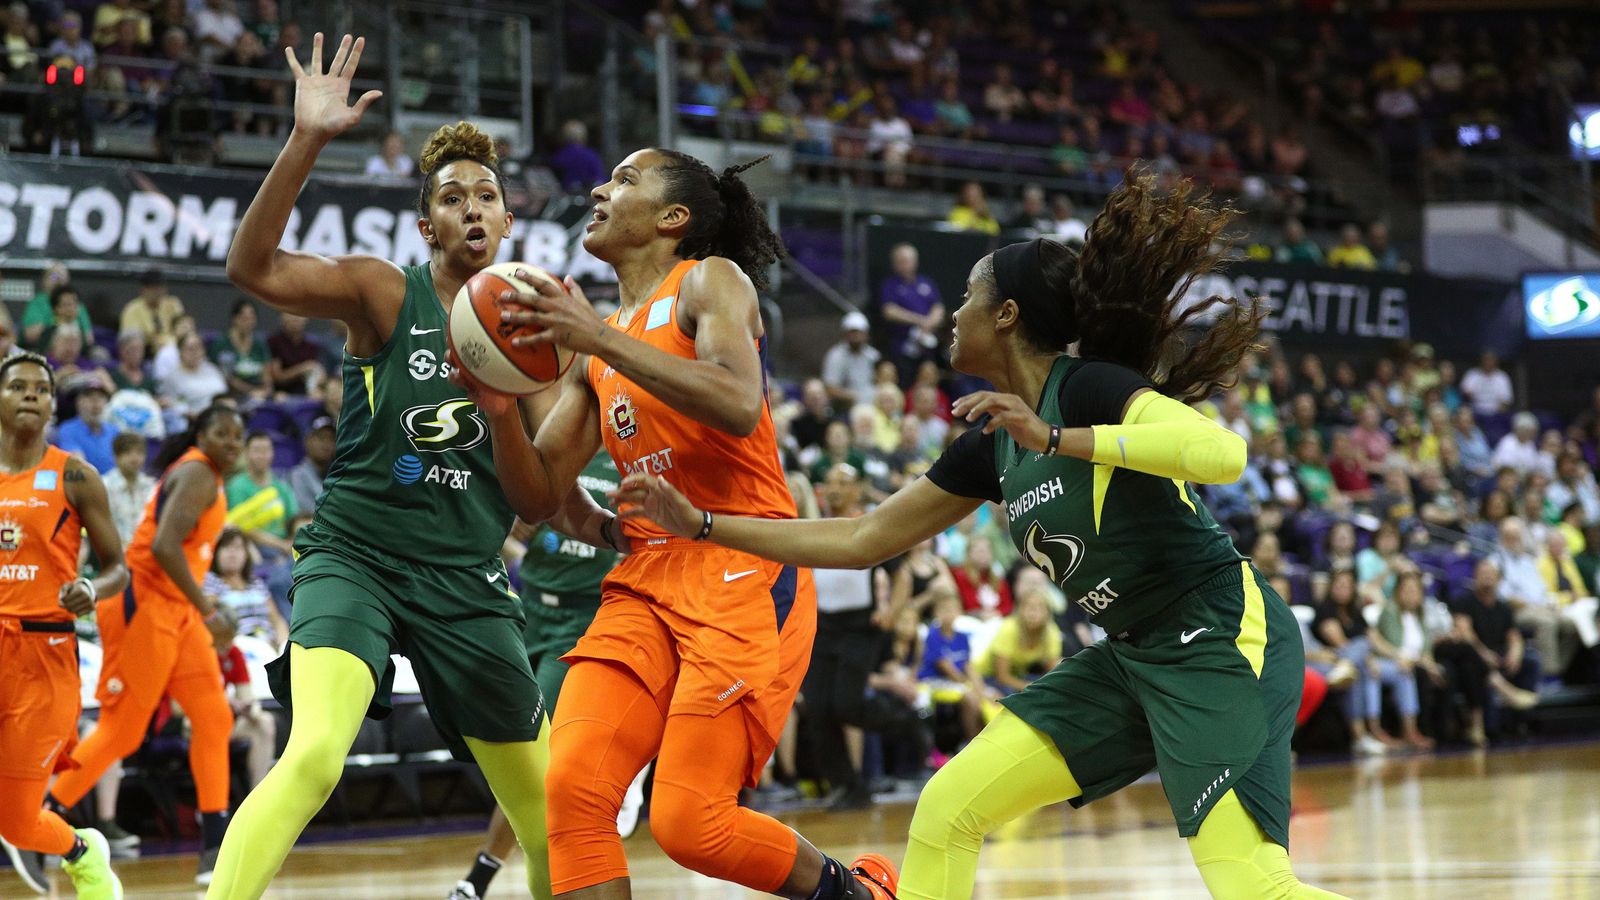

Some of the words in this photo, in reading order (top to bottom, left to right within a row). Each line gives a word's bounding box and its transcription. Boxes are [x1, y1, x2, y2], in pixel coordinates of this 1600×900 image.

[619, 427, 635, 440] SUN
[424, 464, 472, 491] AT&T
[1008, 476, 1064, 522] SWEDISH
[0, 564, 40, 581] AT&T
[1076, 577, 1119, 615] T&T
[1193, 768, 1230, 815] SEATTLE
